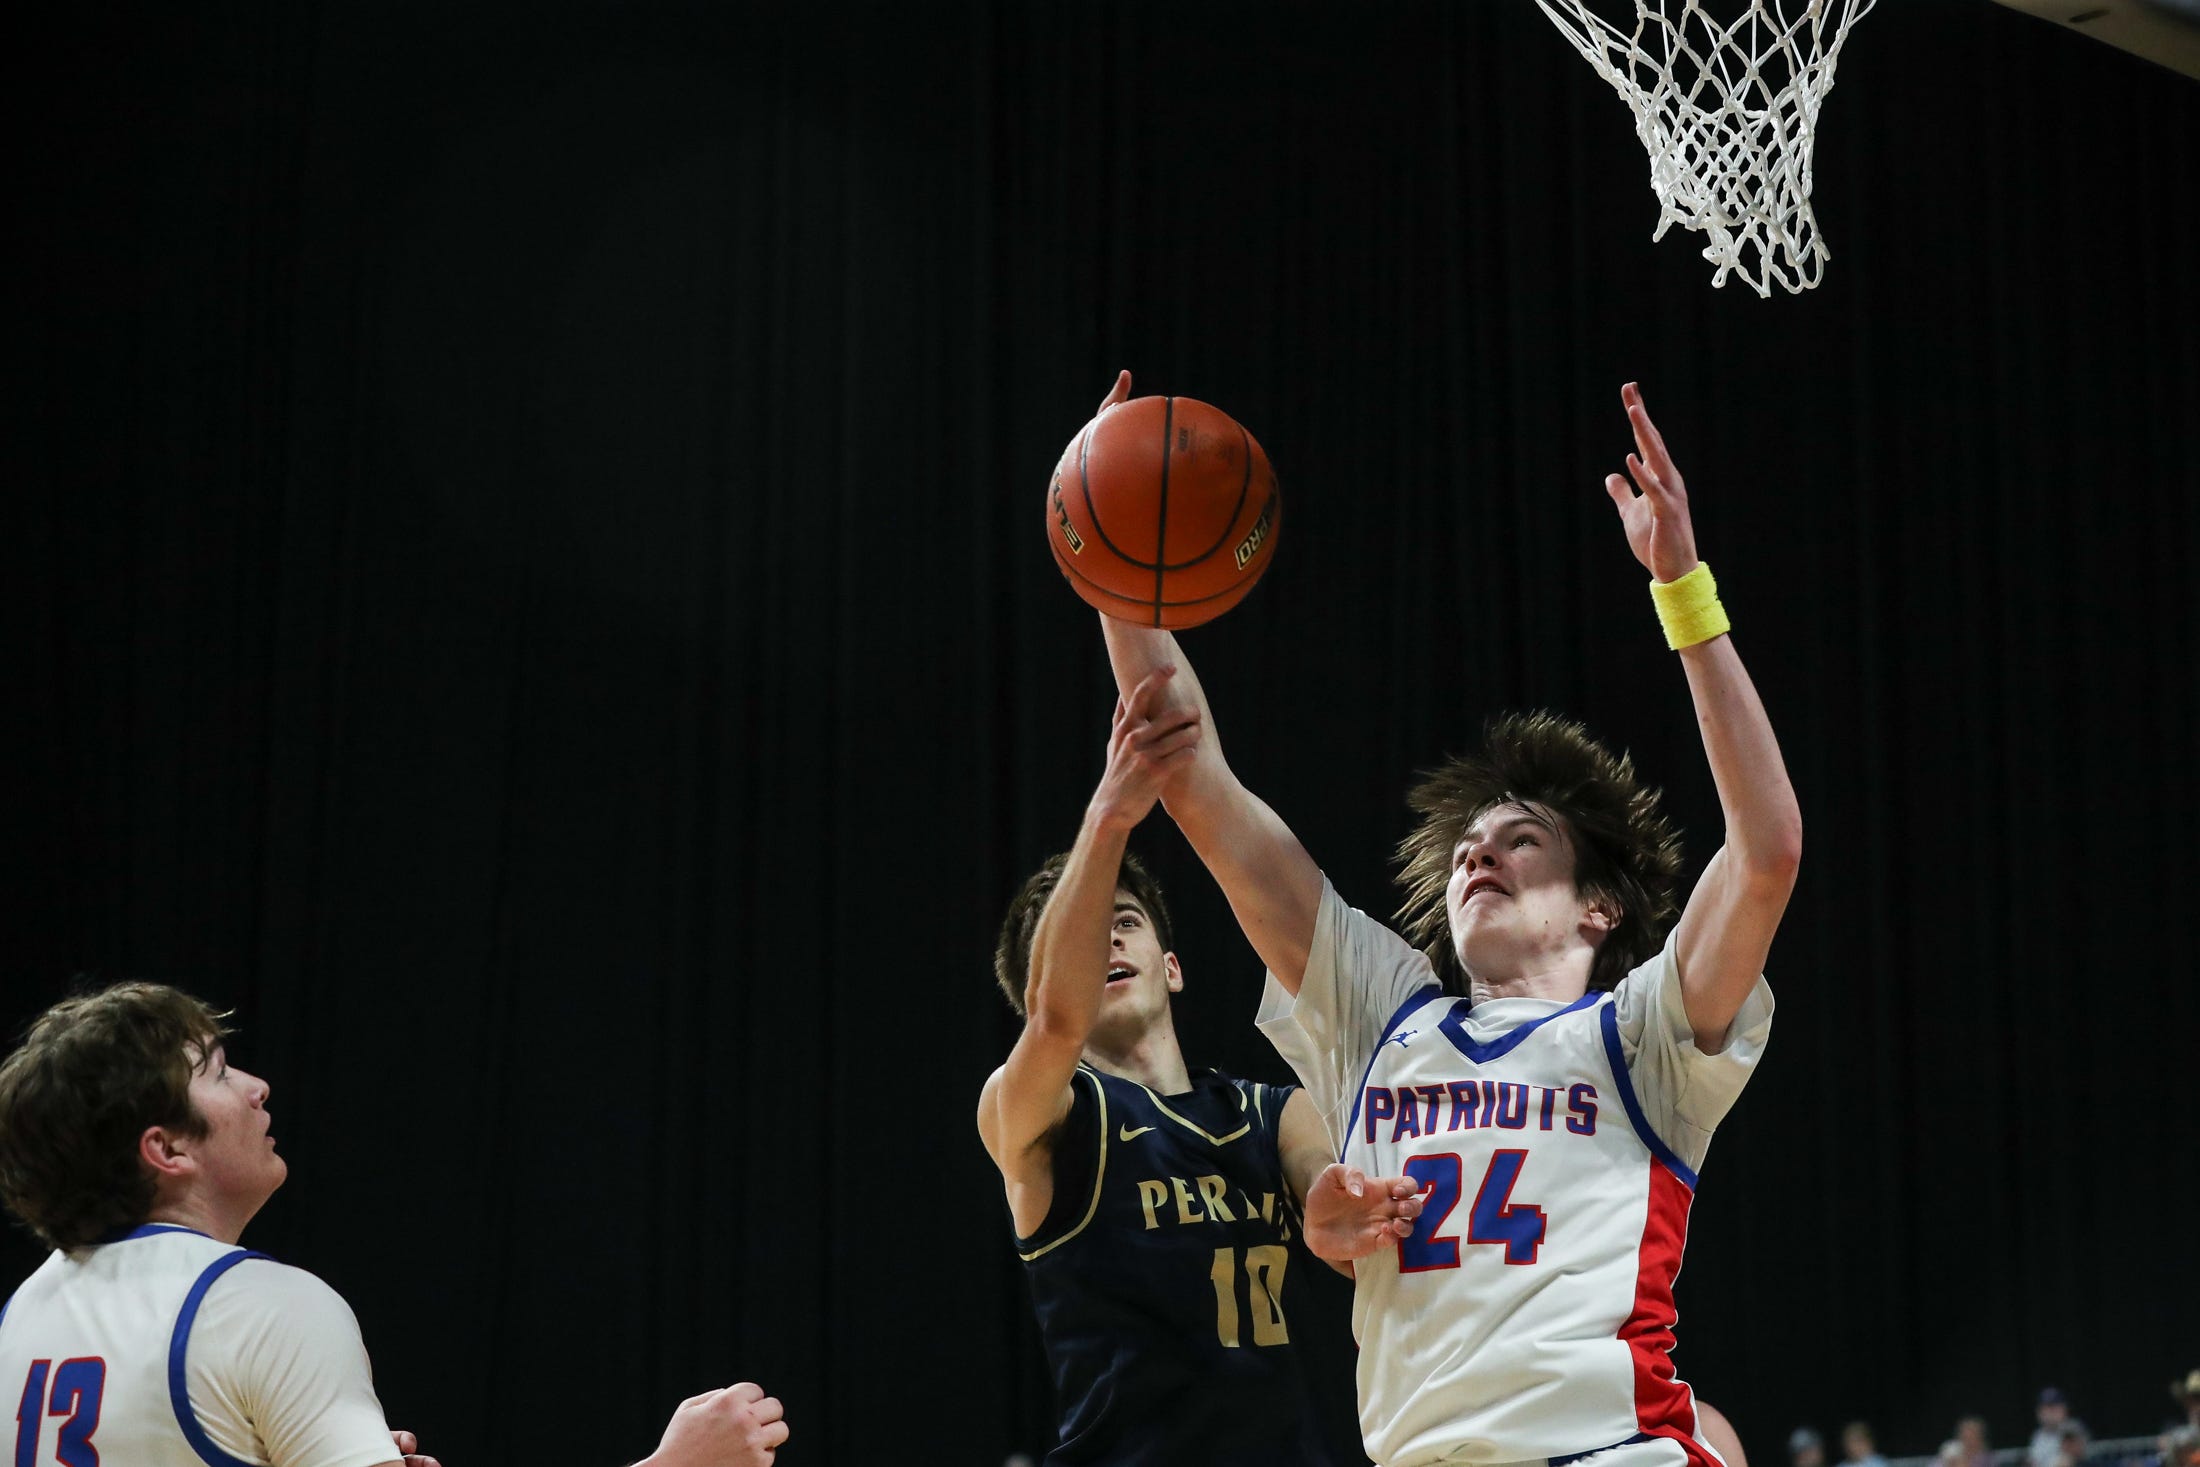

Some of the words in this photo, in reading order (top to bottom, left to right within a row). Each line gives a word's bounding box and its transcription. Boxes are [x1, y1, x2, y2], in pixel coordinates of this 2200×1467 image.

[1238, 515, 1268, 564] PRO
[1365, 1080, 1599, 1144] PATRIOTS
[1397, 1148, 1547, 1273] 24
[1210, 1245, 1290, 1348] 10
[15, 1356, 106, 1467] 13
